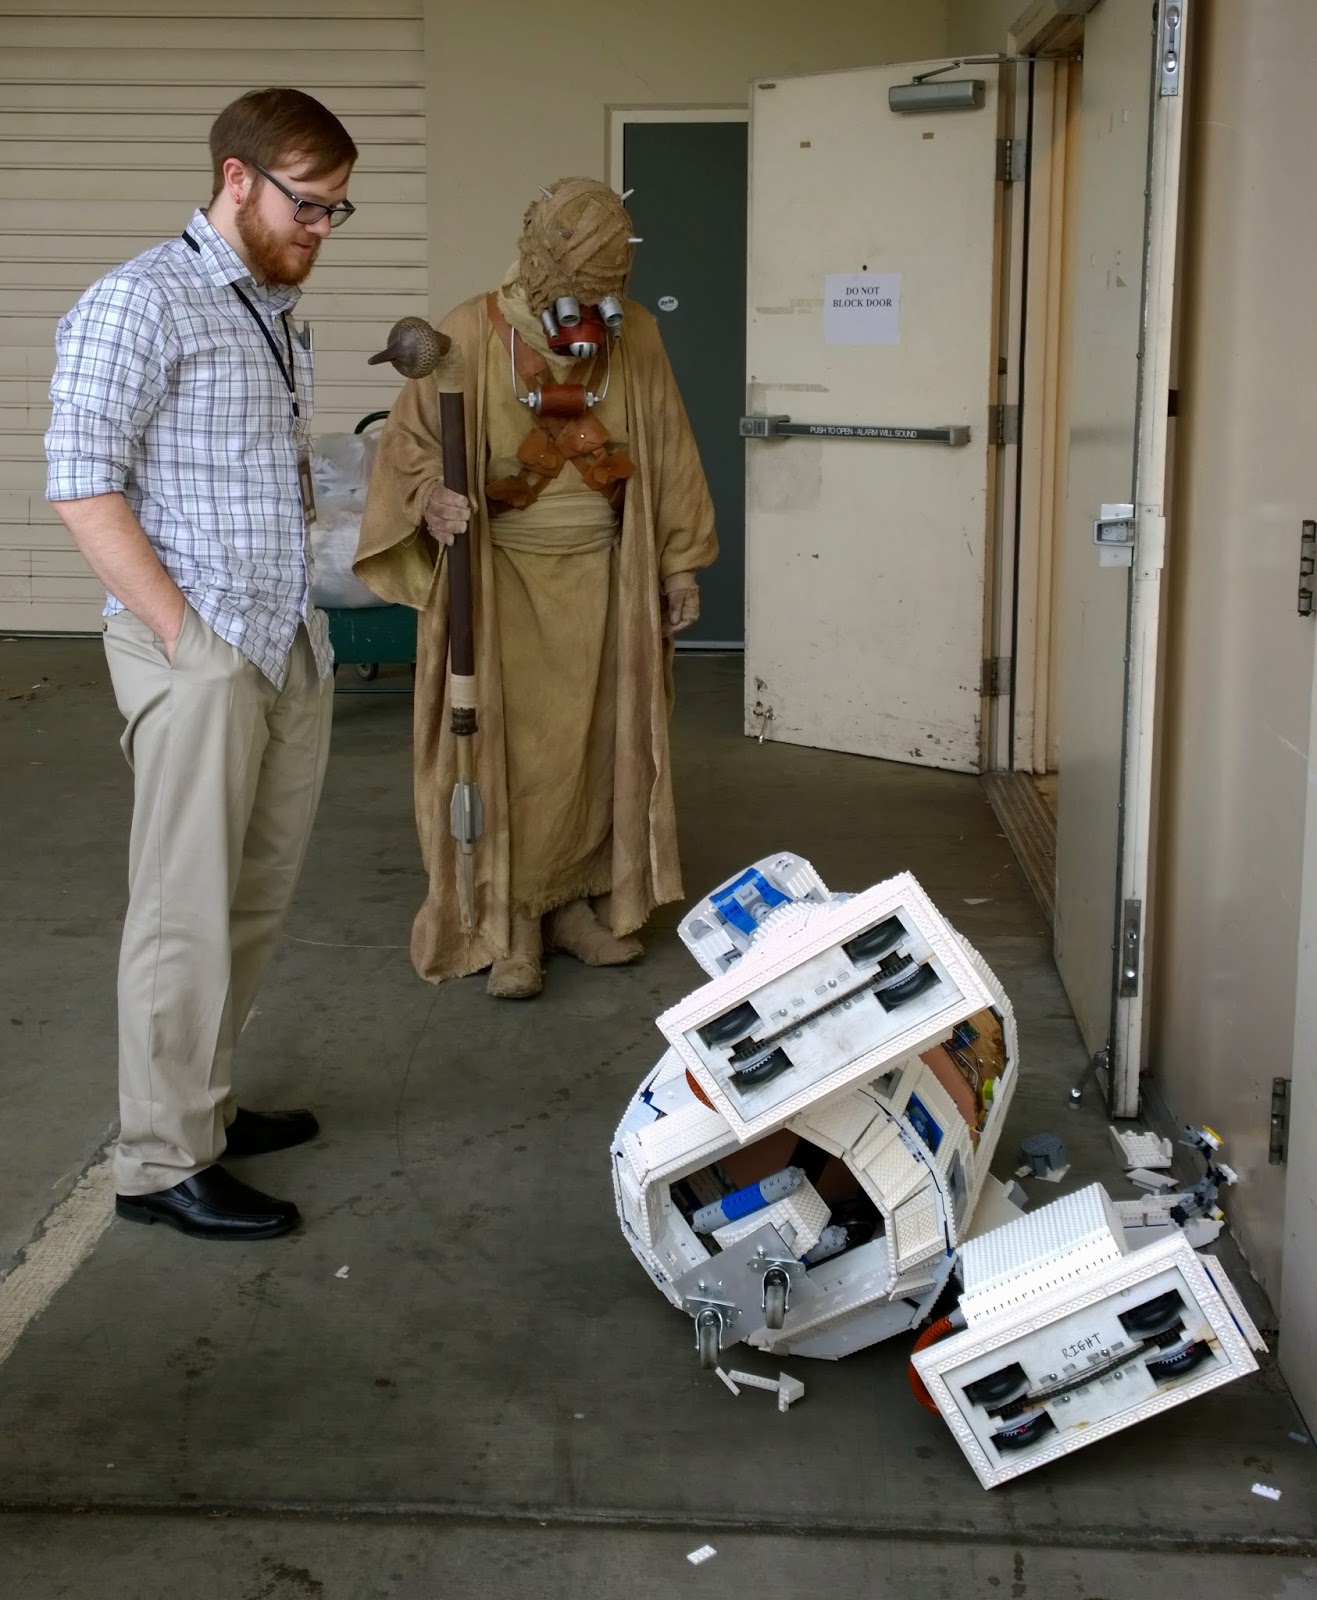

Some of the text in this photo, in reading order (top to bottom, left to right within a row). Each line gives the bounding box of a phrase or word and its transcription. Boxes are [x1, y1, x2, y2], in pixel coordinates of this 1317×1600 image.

[846, 286, 880, 295] DO NOT
[833, 298, 892, 307] BLOCK DOOR
[810, 426, 826, 434] PUSH
[827, 427, 836, 435] TO
[836, 427, 854, 436] OPEN
[857, 428, 878, 436] ALARM
[880, 429, 894, 437] WILL
[895, 430, 917, 438] SOUND
[1061, 1332, 1101, 1360] RIGHT
